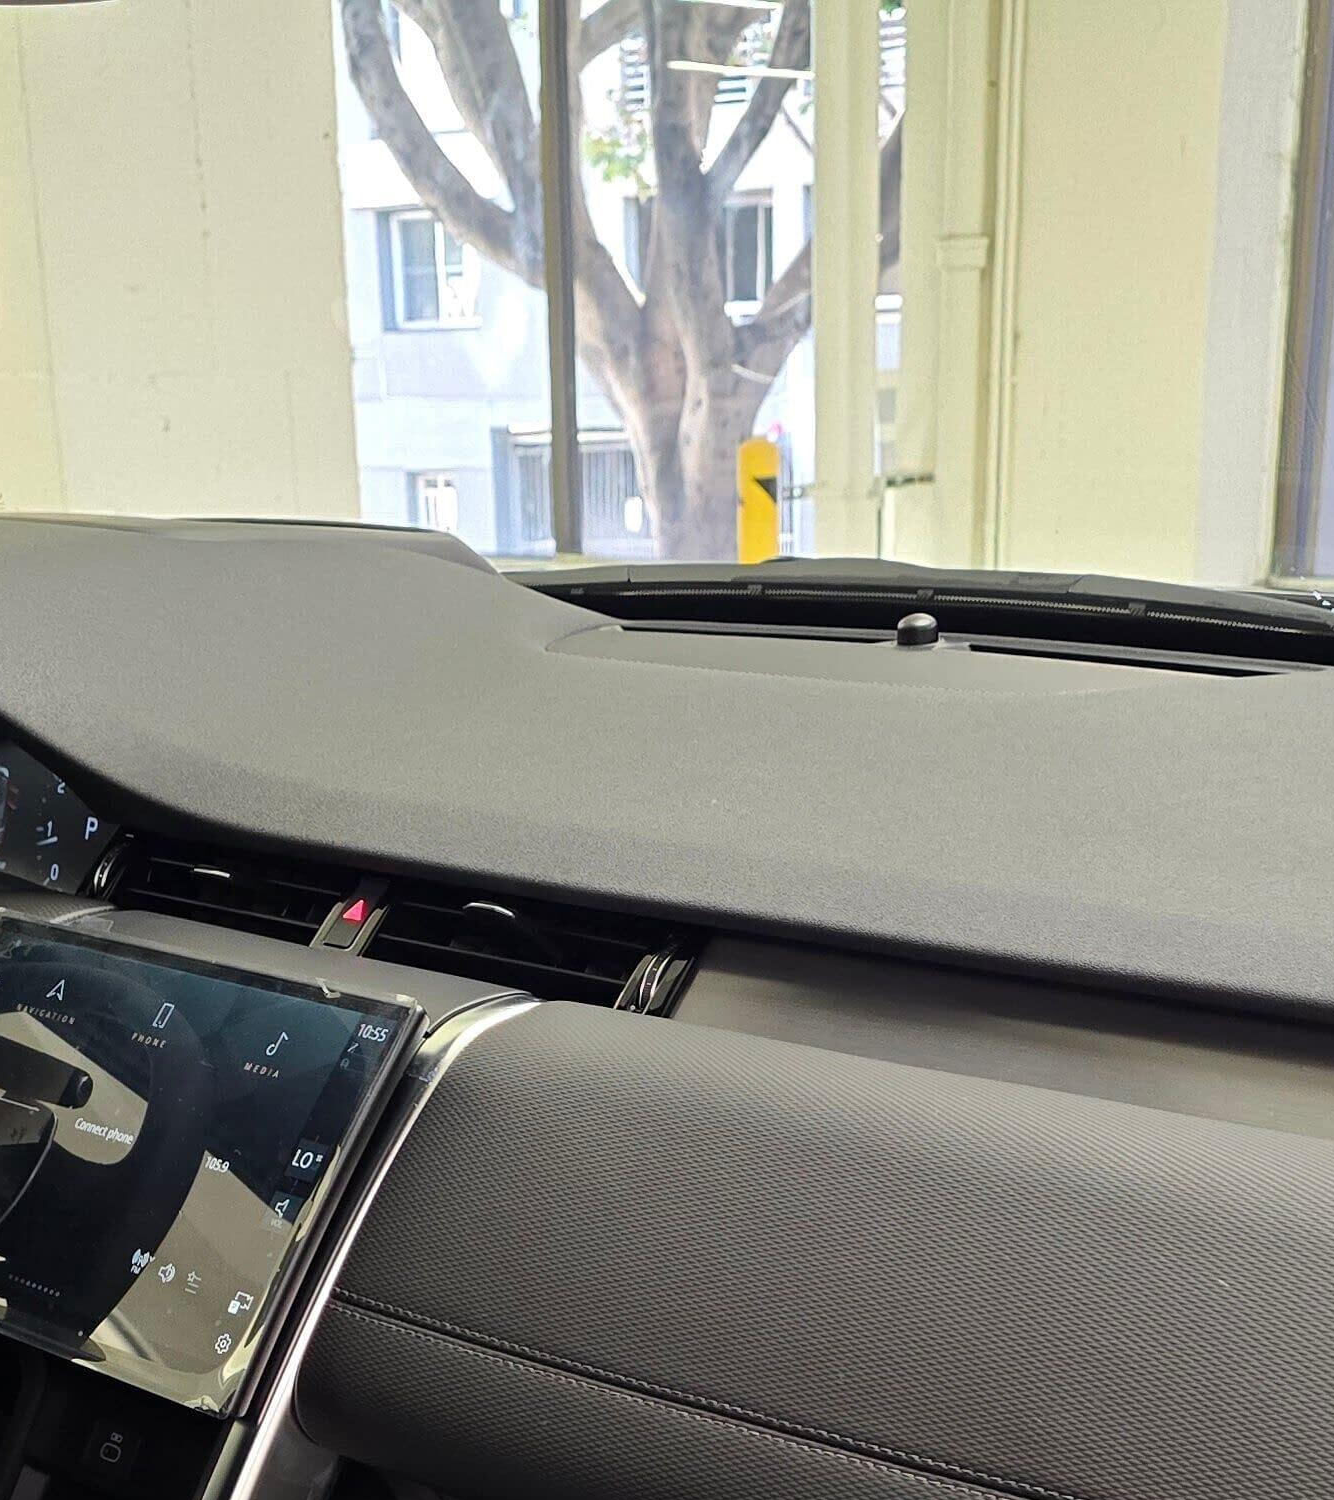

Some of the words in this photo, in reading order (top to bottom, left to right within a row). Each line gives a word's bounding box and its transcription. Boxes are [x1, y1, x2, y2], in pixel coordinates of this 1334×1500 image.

[84, 816, 99, 841] P
[49, 863, 60, 881] 0
[17, 1003, 75, 1026] NAVIGATION
[130, 1031, 167, 1050] PHONE
[358, 1023, 389, 1042] 10:55
[242, 1061, 280, 1079] MEDIA
[74, 1117, 108, 1138] Connect
[105, 1126, 134, 1145] phone
[291, 1148, 314, 1169] LO
